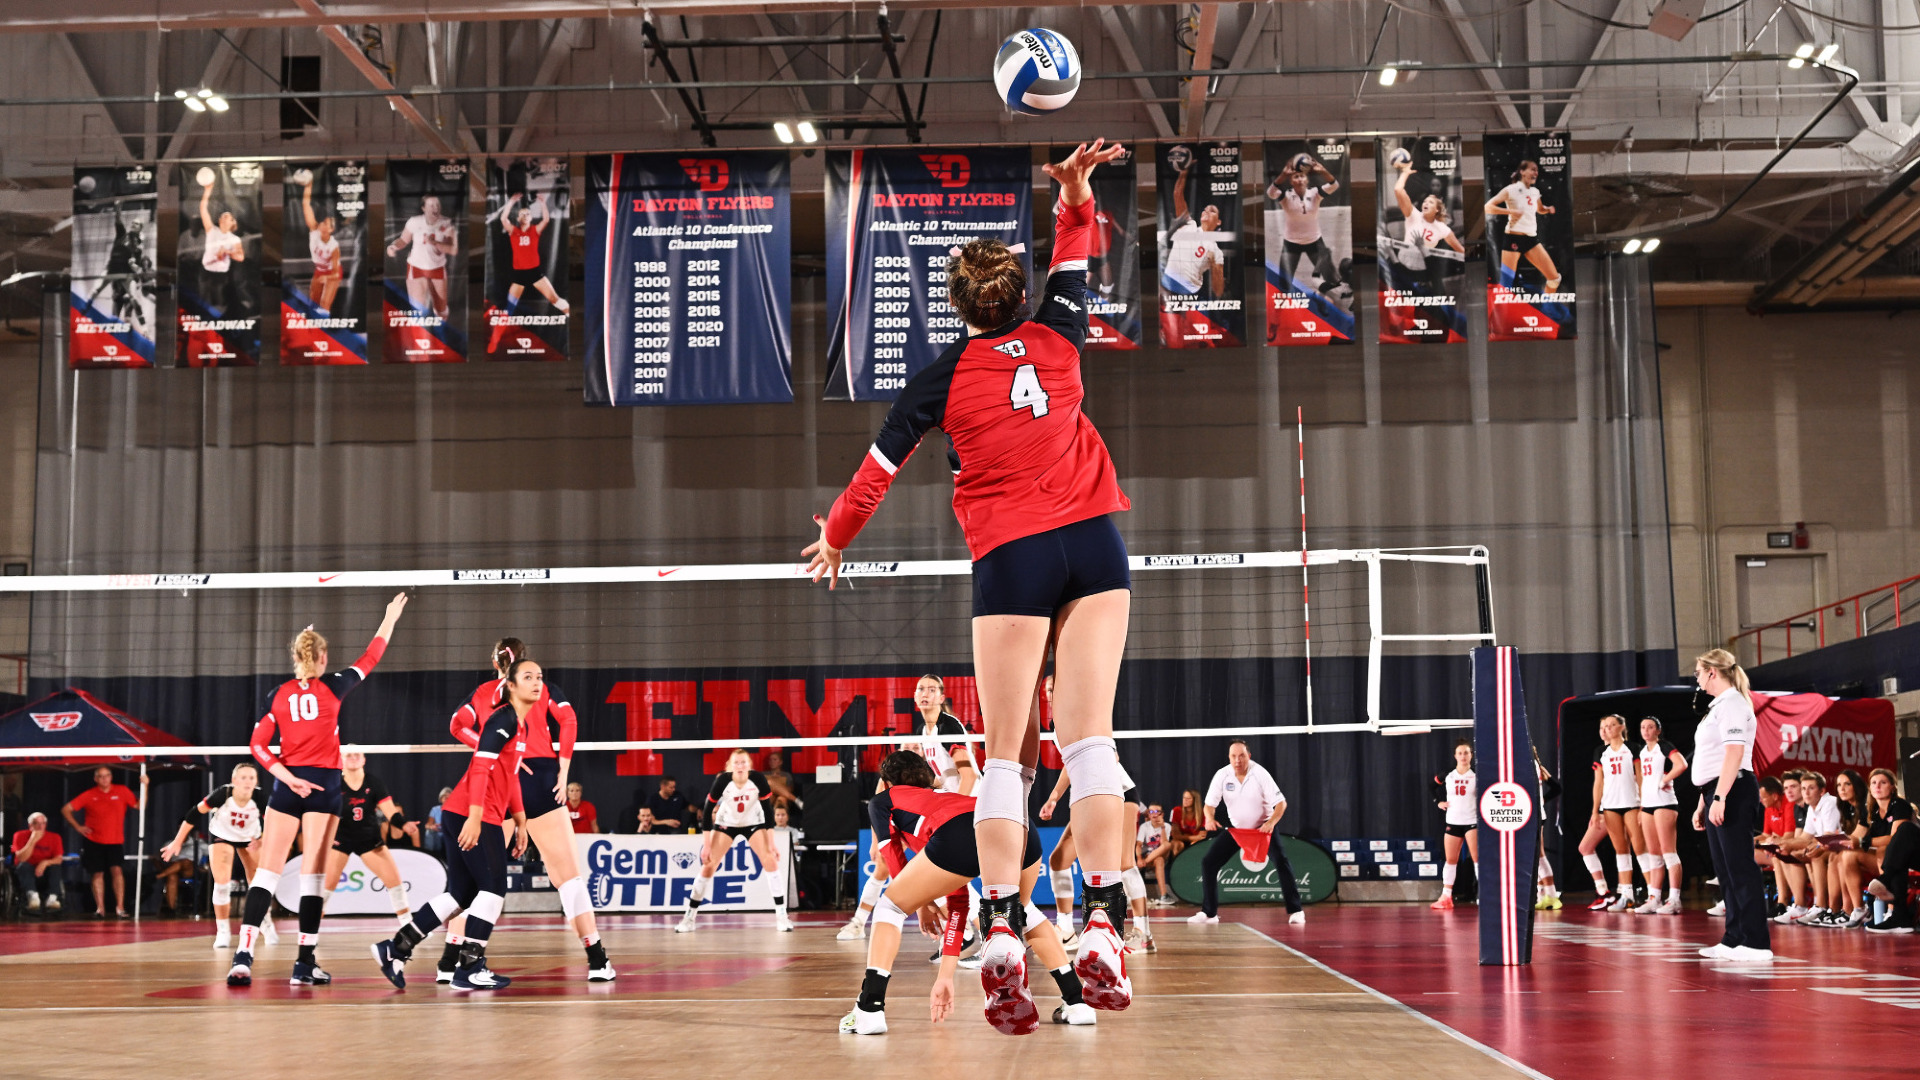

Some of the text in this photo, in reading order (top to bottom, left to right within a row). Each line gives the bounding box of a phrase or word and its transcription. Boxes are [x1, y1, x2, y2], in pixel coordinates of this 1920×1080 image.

[1021, 33, 1052, 68] molten
[1429, 142, 1455, 151] 2011
[1539, 138, 1564, 147] 2011
[1210, 147, 1238, 156] 2008
[1317, 144, 1345, 154] 2010
[439, 165, 467, 173] 2004
[1210, 164, 1239, 174] 2009
[1211, 182, 1238, 191] 2010
[632, 196, 774, 212] DAYTON FLYERS
[872, 193, 1016, 207] DAYTON FLYERS
[632, 223, 773, 236] Atlantic 10 Conference
[870, 219, 1018, 231] Atlantic 10 Tournament
[668, 238, 738, 251] Champions
[634, 261, 666, 273] 1998
[687, 260, 720, 271] 2012
[874, 256, 911, 268] 2003
[927, 256, 950, 267] 20
[634, 276, 670, 288] 2000
[687, 275, 720, 287] 2014
[874, 271, 911, 282] 2004
[927, 271, 949, 282] 20
[634, 292, 670, 302] 2004
[687, 290, 720, 302] 2015
[874, 286, 911, 298] 2005
[927, 286, 949, 298] 20
[1274, 299, 1310, 309] YANZ
[1384, 295, 1456, 307] CAMPBELL
[1494, 293, 1576, 304] KRABACHER
[687, 305, 720, 317] 2016
[874, 302, 909, 313] 2007
[1165, 300, 1241, 312] FLETEMIER
[634, 306, 670, 318] 2005
[182, 320, 256, 331] TREADWAY
[287, 318, 358, 330] BARHORST
[389, 316, 443, 327] UTNAGE
[489, 315, 566, 326] SCHROEDER
[874, 317, 911, 328] 2009
[75, 323, 131, 334] MEYERS
[634, 322, 670, 333] 2006
[687, 321, 723, 332] 2020
[634, 337, 669, 348] 2007
[687, 336, 720, 347] 2021
[874, 332, 907, 343] 2010
[634, 352, 670, 363] 2009
[874, 347, 903, 359] 2011
[634, 367, 667, 379] 2010
[874, 363, 907, 374] 2012
[634, 383, 663, 394] 2011
[874, 378, 906, 389] 2014
[1009, 363, 1050, 419] 4
[1150, 554, 1240, 566] DAYTON FLYERS
[845, 562, 894, 573] LEGACY
[458, 569, 502, 580] DAYTON
[288, 693, 319, 722] 10
[1779, 723, 1875, 768] DAYTON
[1610, 763, 1622, 774] 31
[352, 807, 363, 821] 3
[588, 839, 668, 876] Gem
